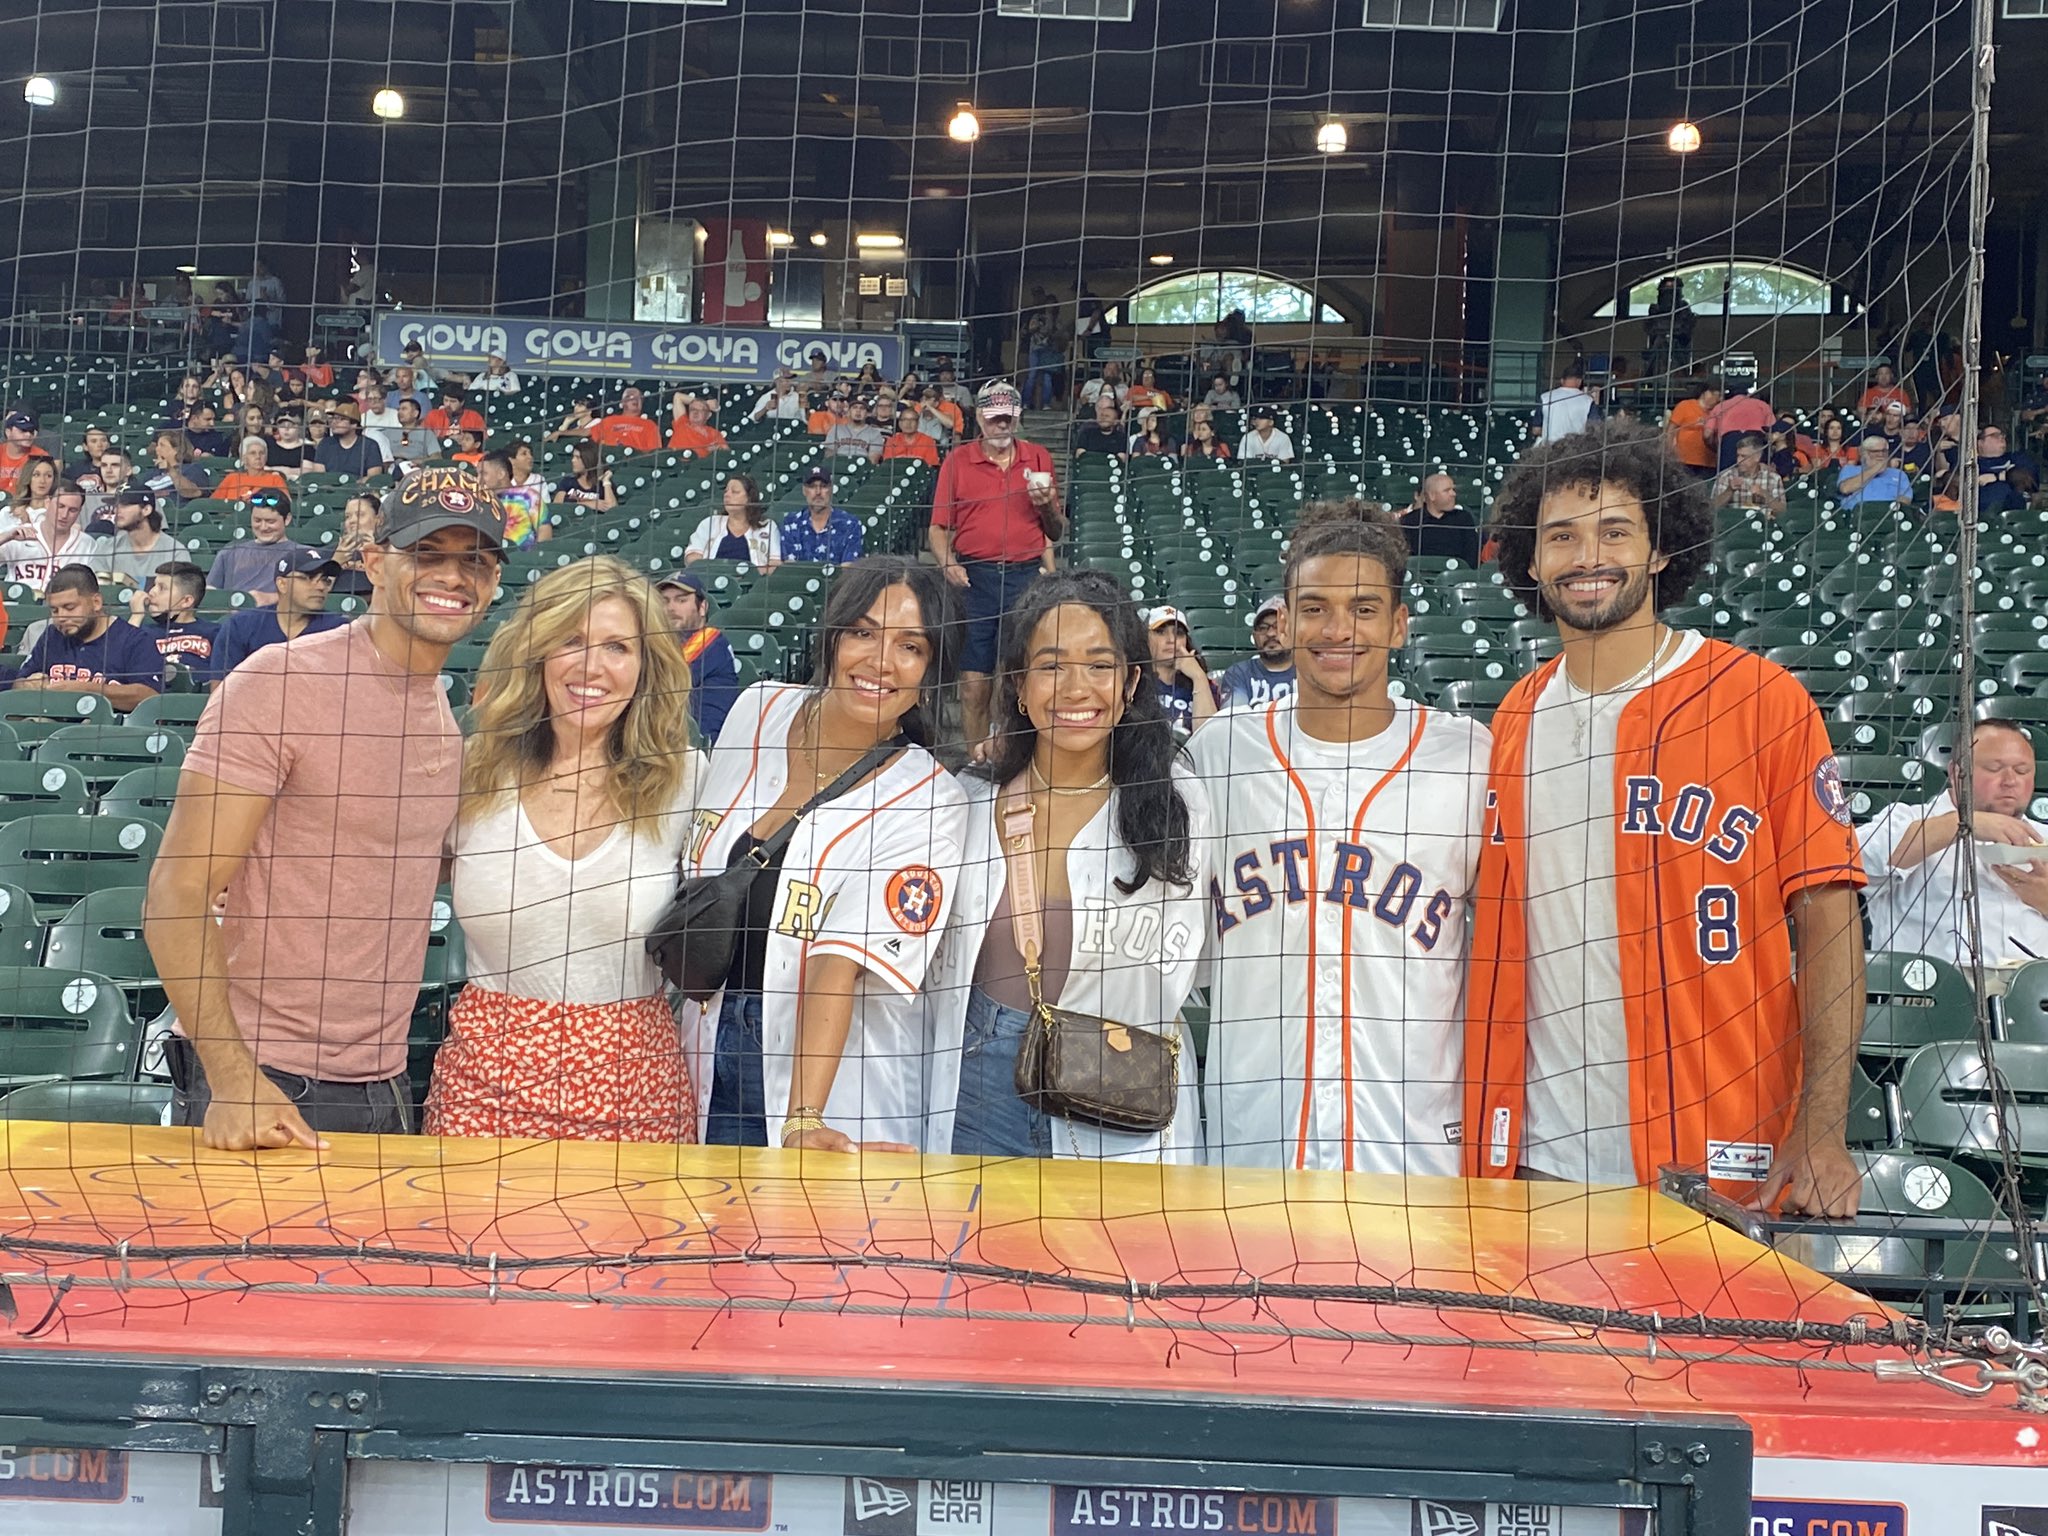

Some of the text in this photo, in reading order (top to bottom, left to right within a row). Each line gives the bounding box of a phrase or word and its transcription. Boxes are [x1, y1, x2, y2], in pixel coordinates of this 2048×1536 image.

[399, 321, 883, 370] GOYA GOYA GOYA GOYA
[50, 664, 122, 685] STRO
[1622, 775, 1763, 864] ROS
[776, 879, 838, 943] R
[1211, 838, 1452, 953] ASTROS
[1078, 896, 1192, 976] ROS
[1695, 884, 1741, 965] 8
[506, 1468, 751, 1512] ASTROS.COM
[929, 1501, 982, 1524] ERA
[930, 1480, 982, 1500] NEW
[1070, 1489, 1316, 1535] ASTROS.COM
[1497, 1504, 1550, 1526] NEW
